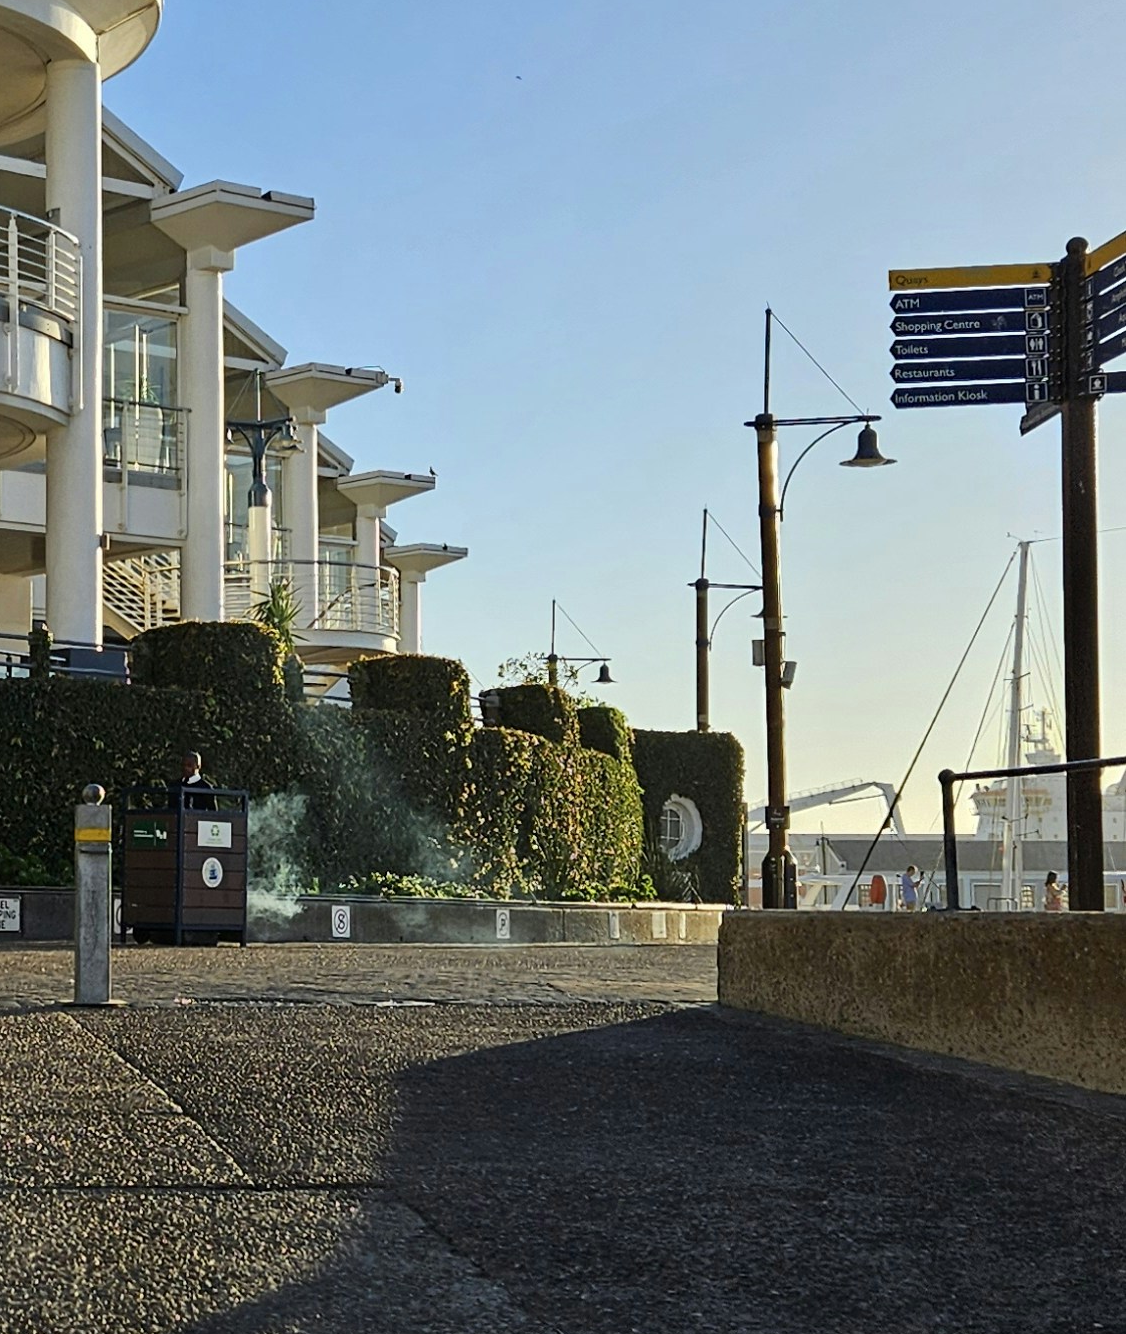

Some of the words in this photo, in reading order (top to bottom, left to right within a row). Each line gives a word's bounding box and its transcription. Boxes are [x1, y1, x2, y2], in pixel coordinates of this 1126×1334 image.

[895, 275, 928, 286] Quays
[895, 298, 920, 309] ATM
[895, 321, 942, 334] Shopping
[944, 320, 980, 330] Centre
[895, 345, 928, 355] Toilets
[894, 368, 955, 379] Restaurants
[895, 392, 954, 404] Information
[958, 389, 988, 400] Kiosk
